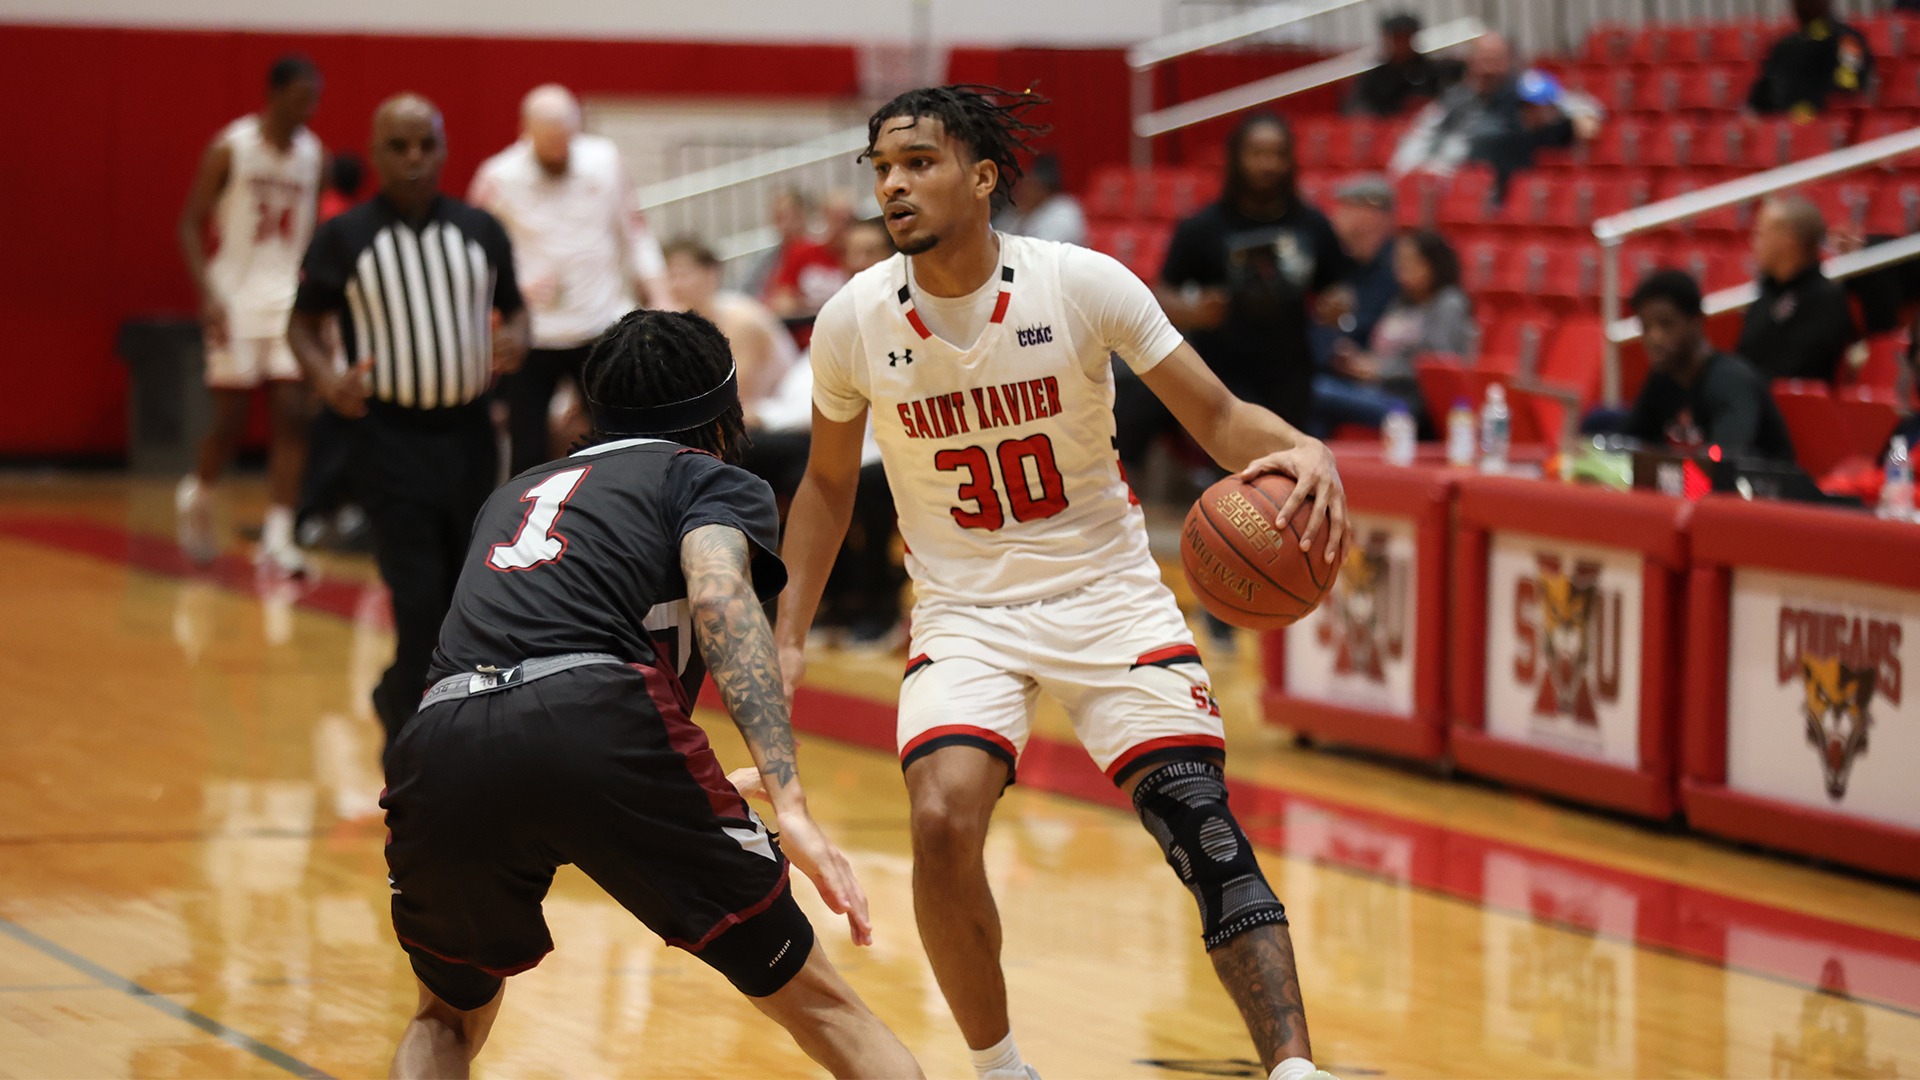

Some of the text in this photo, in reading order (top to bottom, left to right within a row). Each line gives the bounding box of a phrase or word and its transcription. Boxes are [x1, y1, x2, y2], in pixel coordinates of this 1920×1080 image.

[1018, 326, 1053, 347] CCAC
[897, 376, 1062, 439] SAINT XAVIER
[485, 465, 592, 573] 1
[935, 433, 1070, 532] 30
[1186, 517, 1262, 603] SPALDING
[1216, 494, 1280, 566] LEGACY
[1778, 606, 1903, 707] COUGARS
[1168, 761, 1217, 778] NEENCA
